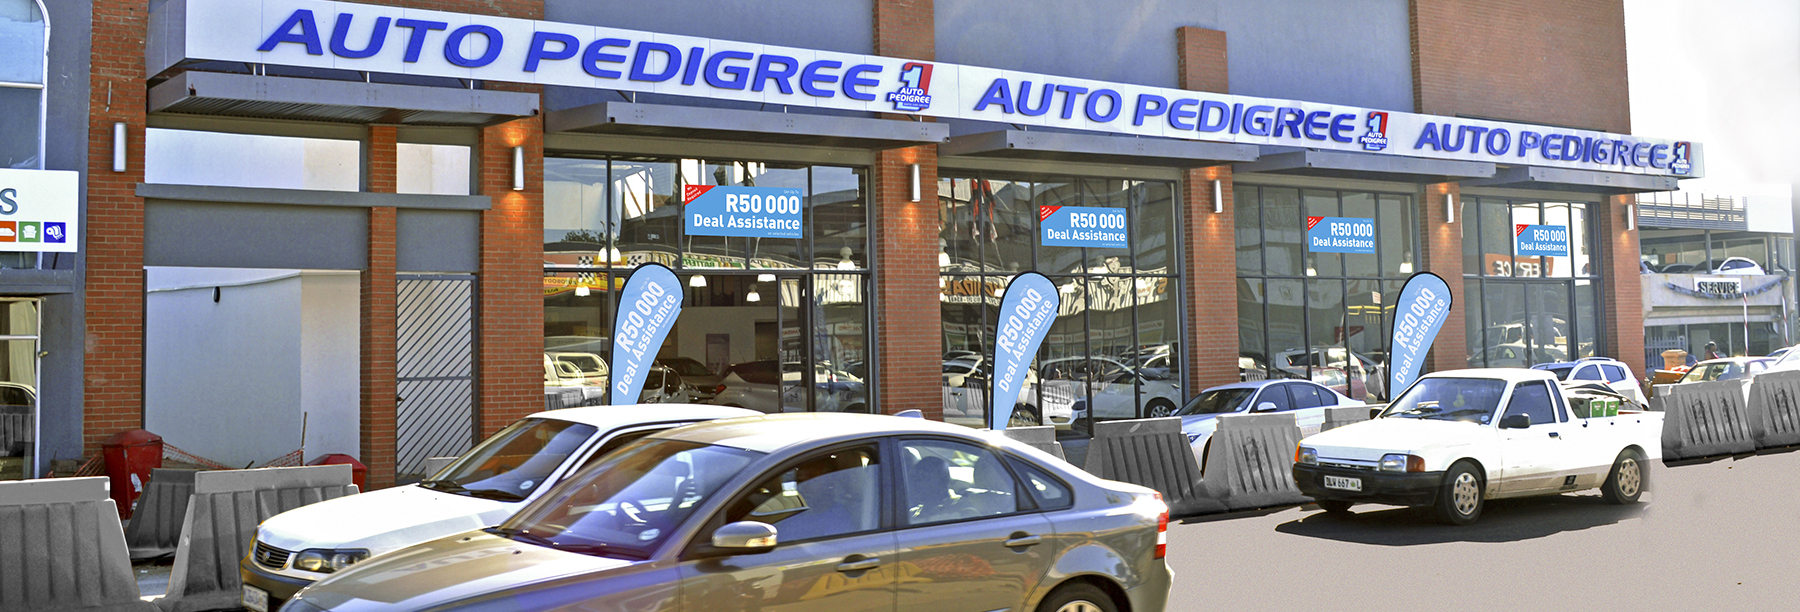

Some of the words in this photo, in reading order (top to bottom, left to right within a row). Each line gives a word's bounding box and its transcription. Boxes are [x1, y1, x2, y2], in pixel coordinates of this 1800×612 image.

[257, 9, 504, 68] AUTO
[523, 31, 884, 102] PEDIGREE
[889, 93, 930, 104] PEDIGREE
[900, 87, 924, 96] AUTO
[974, 78, 1123, 123] AUTO
[1133, 93, 1356, 143] PEDIGREE
[1414, 121, 1512, 156] AUTO
[1518, 131, 1669, 169] PEDIGREE
[726, 193, 762, 213] R50
[765, 195, 800, 214] 000
[693, 213, 724, 228] Deal
[727, 214, 800, 230] Assistance
[1070, 212, 1097, 228] R50
[1099, 213, 1125, 229] 000
[1330, 222, 1351, 236] R50
[1353, 223, 1373, 237] 000
[1047, 228, 1070, 239] Deal
[1072, 229, 1125, 241] Assistance
[1313, 236, 1331, 247] Deal
[1332, 237, 1374, 248] Assistance
[1533, 229, 1550, 242] R50
[1550, 230, 1566, 242] 000
[1520, 241, 1534, 251] Deal
[1535, 242, 1567, 252] Assistance
[1698, 281, 1740, 294] SERVICE
[615, 311, 645, 353] R50
[635, 281, 665, 316] 000
[997, 315, 1024, 354] R50
[1015, 288, 1043, 320] 000
[1394, 312, 1419, 349] R50
[1410, 287, 1436, 317] 000
[616, 359, 639, 396] Deal
[631, 294, 677, 362] Assistance
[998, 359, 1019, 393] Deal
[1012, 300, 1053, 362] Assistance
[1395, 353, 1414, 385] Deal
[1407, 299, 1446, 356] Assistance
